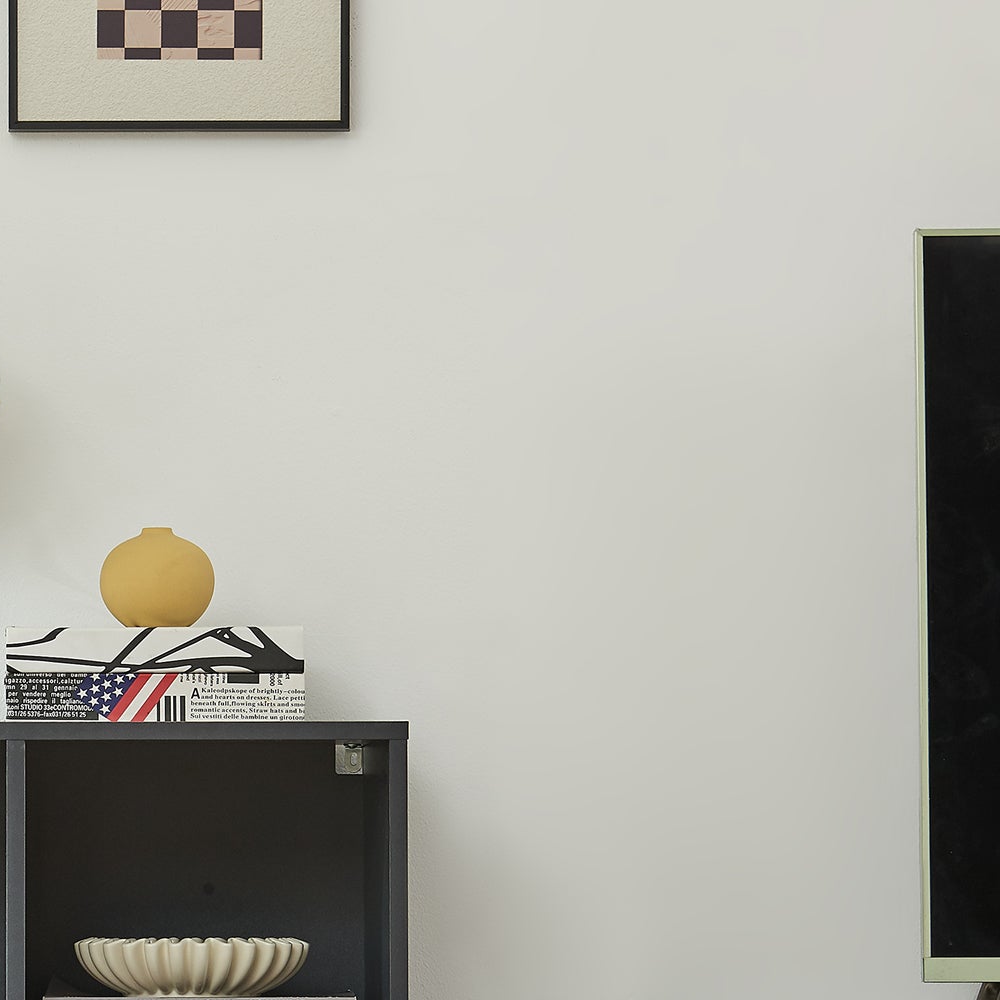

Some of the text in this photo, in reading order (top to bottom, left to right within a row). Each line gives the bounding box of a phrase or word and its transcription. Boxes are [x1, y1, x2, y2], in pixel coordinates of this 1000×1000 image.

[19, 683, 28, 691] 29
[50, 691, 71, 699] meglio
[190, 687, 200, 699] A
[22, 697, 48, 705] rispedire
[20, 703, 43, 711] STUDIO
